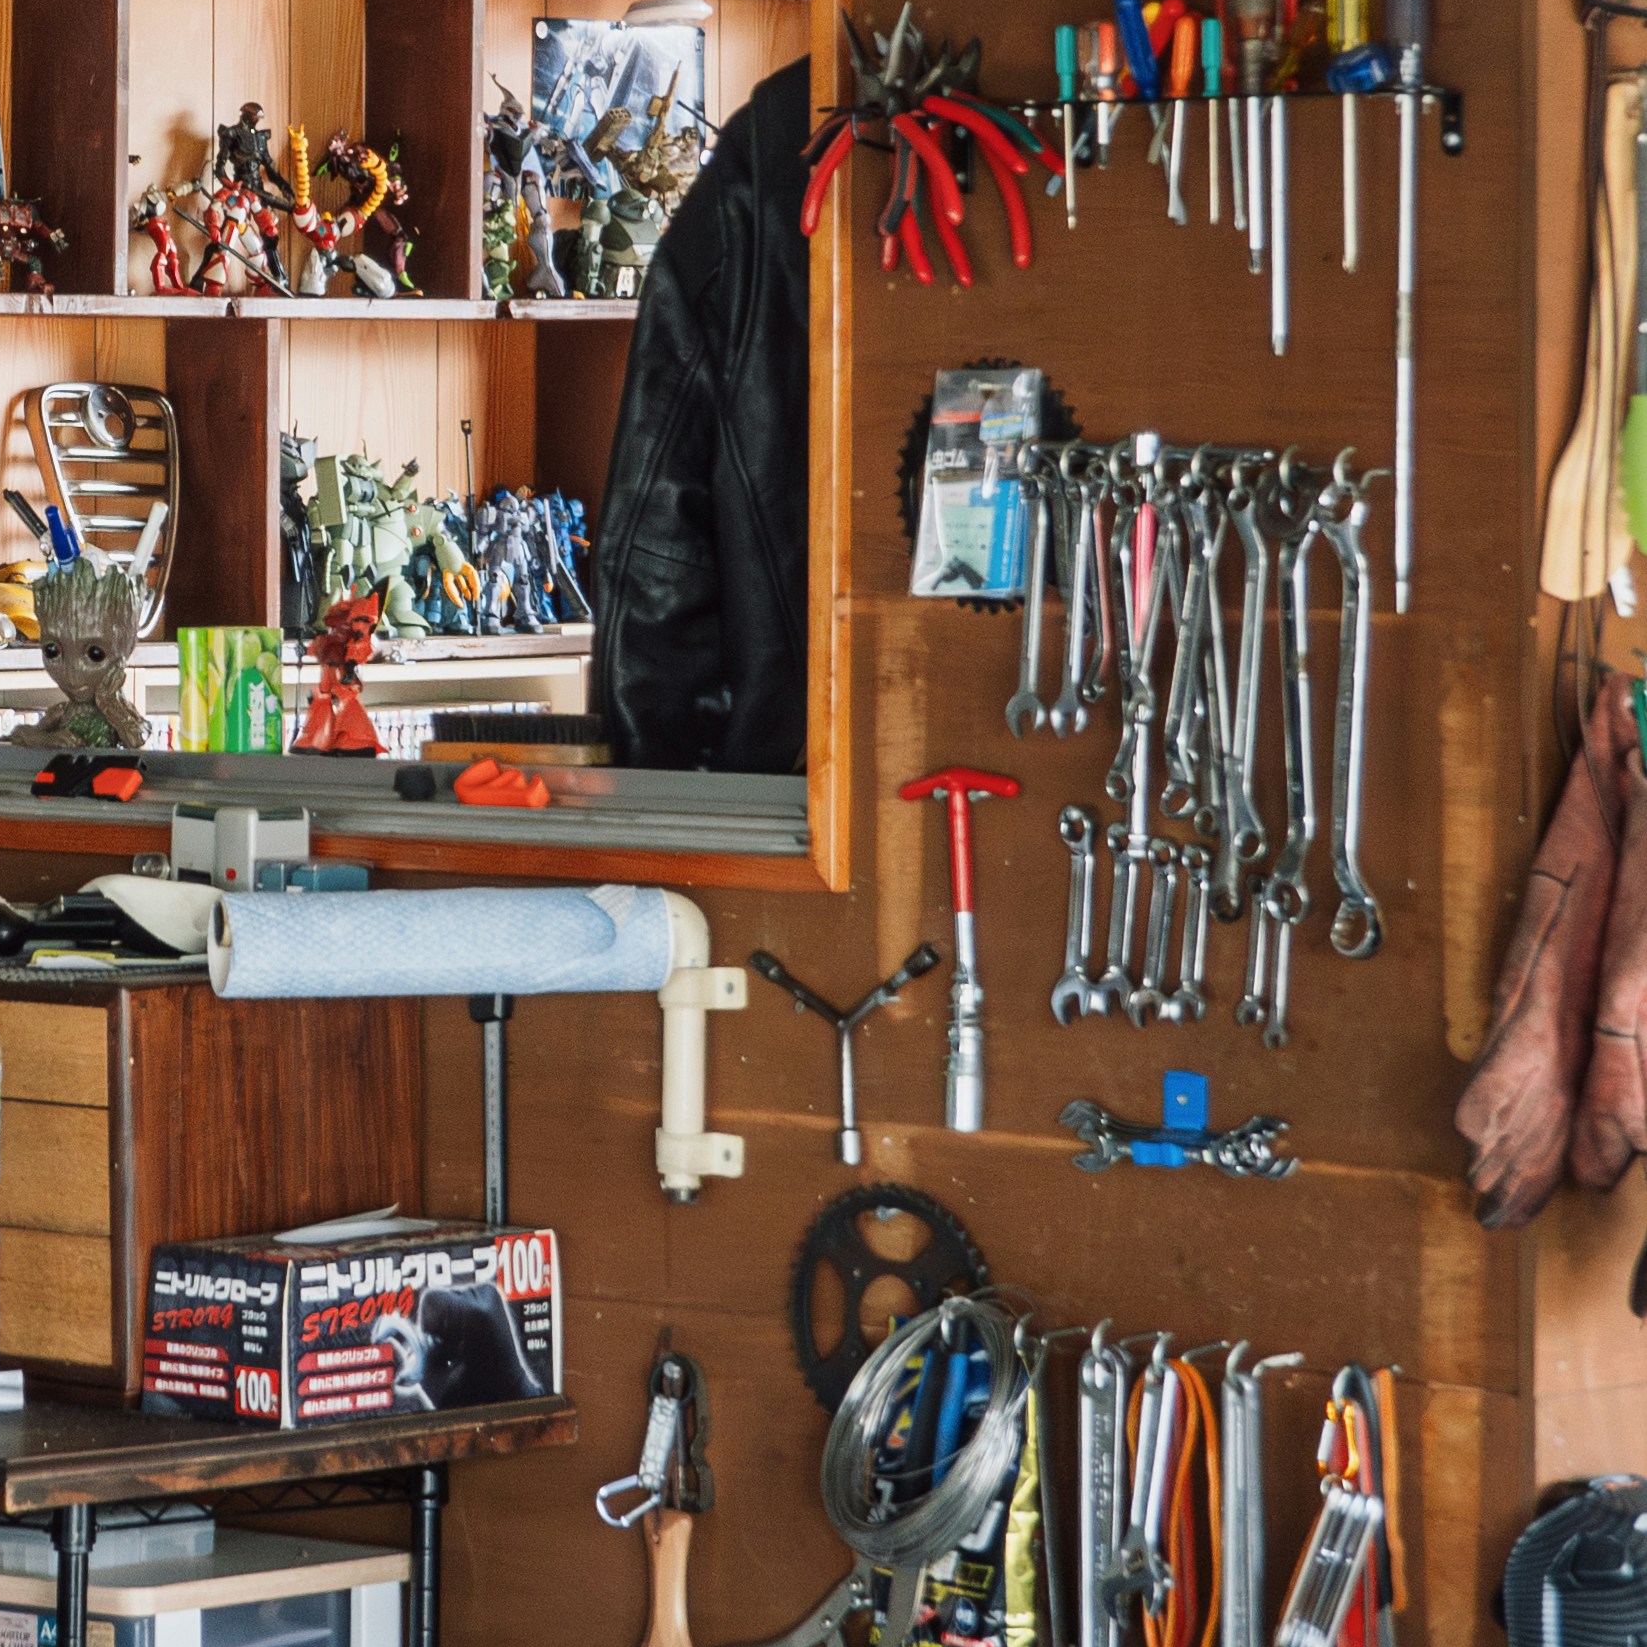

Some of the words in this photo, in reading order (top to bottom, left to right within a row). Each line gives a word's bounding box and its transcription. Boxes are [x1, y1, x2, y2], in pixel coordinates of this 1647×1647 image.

[155, 1269, 278, 1305] ニトリルグローブ
[300, 1245, 497, 1302] ニトリルグローブ
[497, 1237, 543, 1295] 100
[152, 1303, 235, 1332] STRONG
[301, 1285, 415, 1343] STRONG
